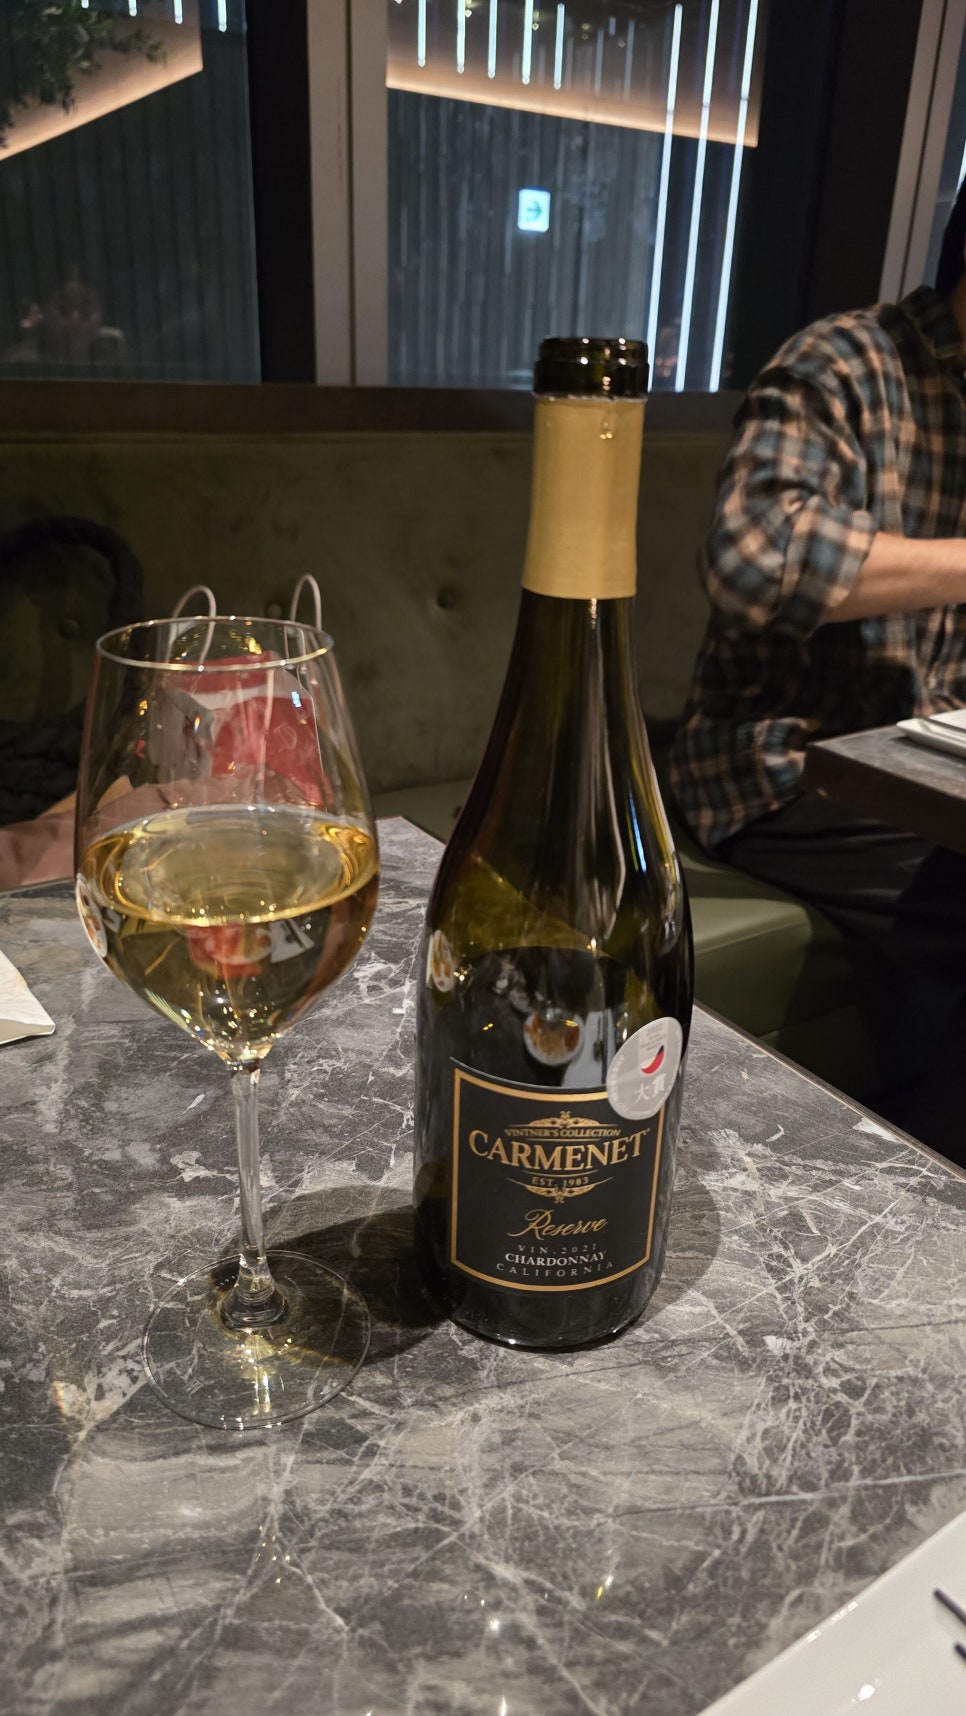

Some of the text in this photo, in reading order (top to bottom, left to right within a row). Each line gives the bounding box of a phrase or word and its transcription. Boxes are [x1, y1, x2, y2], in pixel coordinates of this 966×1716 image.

[504, 1128, 621, 1138] VINTNER'S COLLECTION
[468, 1129, 647, 1171] CARMENET
[531, 1176, 589, 1187] EST. 1983
[506, 1209, 608, 1240] Reserve
[561, 1243, 597, 1255] 2021
[504, 1250, 607, 1267] CHARDONNAY
[496, 1261, 613, 1277] CALIFORNIA
